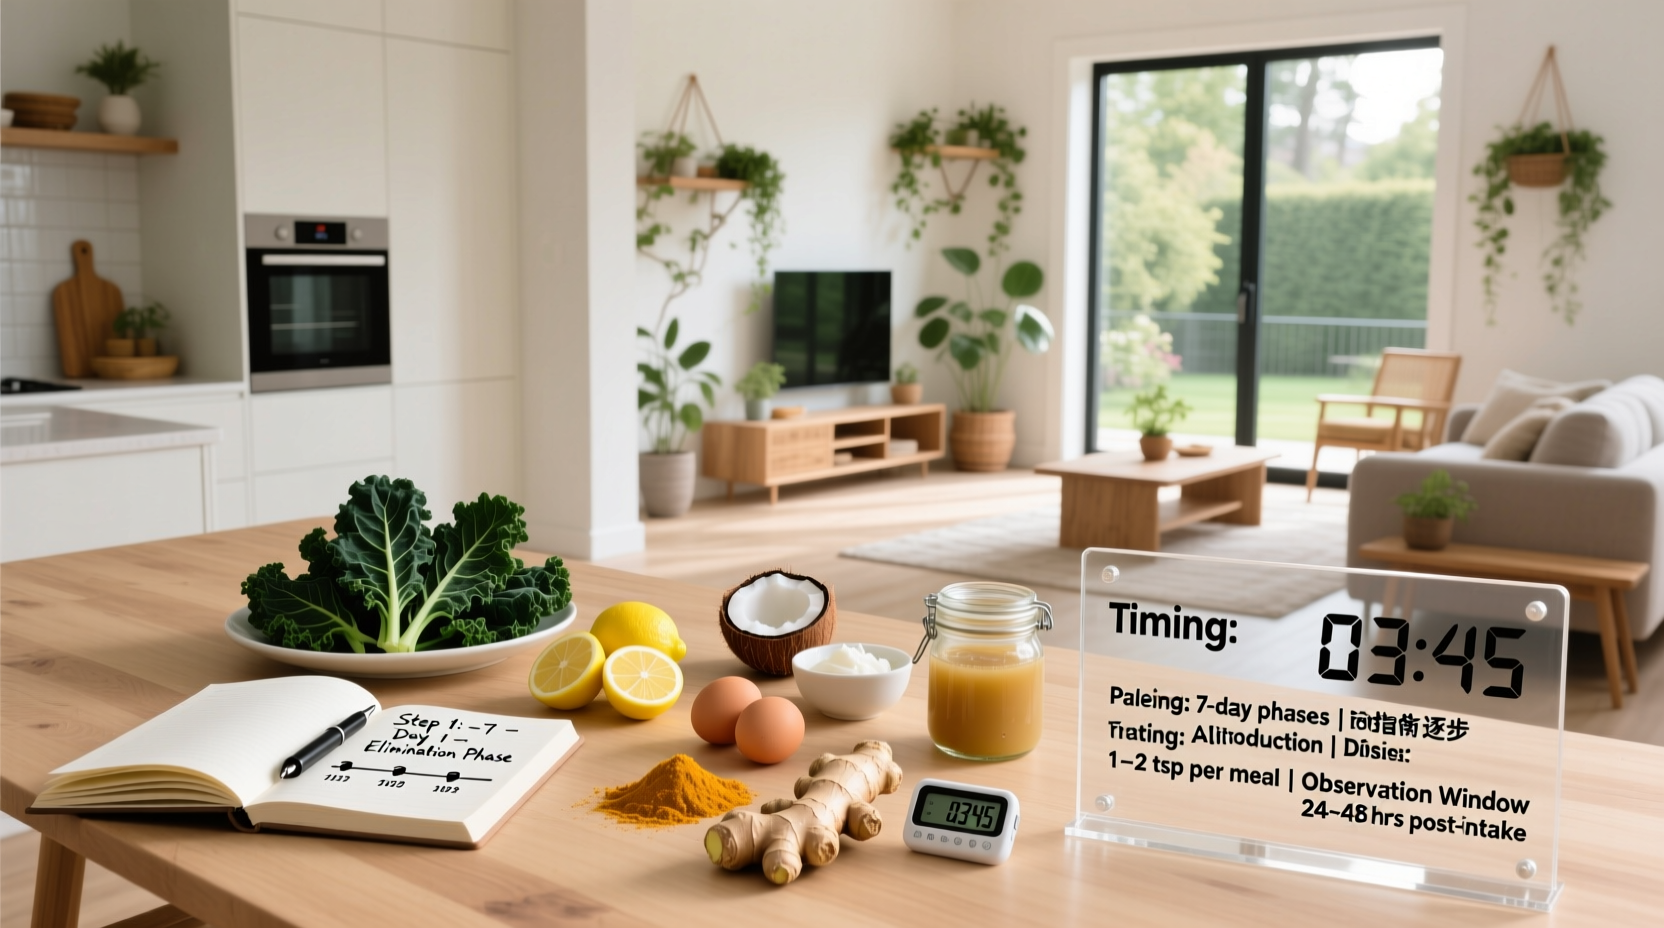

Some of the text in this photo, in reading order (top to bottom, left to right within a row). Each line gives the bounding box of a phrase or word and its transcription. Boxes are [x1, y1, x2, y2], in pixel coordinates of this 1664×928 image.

[1109, 601, 1237, 652] Timing:
[1318, 613, 1527, 699] 03:45
[392, 713, 440, 734] Step
[449, 718, 463, 731] 1:
[1110, 686, 1190, 716] Paleing:
[1196, 694, 1252, 723] 7-day
[1257, 701, 1330, 725] phases
[363, 739, 513, 763] Elimination Phase
[392, 728, 430, 747] Day
[1153, 755, 1184, 780] tsp
[1189, 763, 1224, 783] per
[1229, 767, 1280, 787] meal
[1301, 771, 1433, 804] Observation
[1438, 785, 1531, 815] Window
[1371, 805, 1404, 828] hrs
[1409, 814, 1527, 842] post-intake
